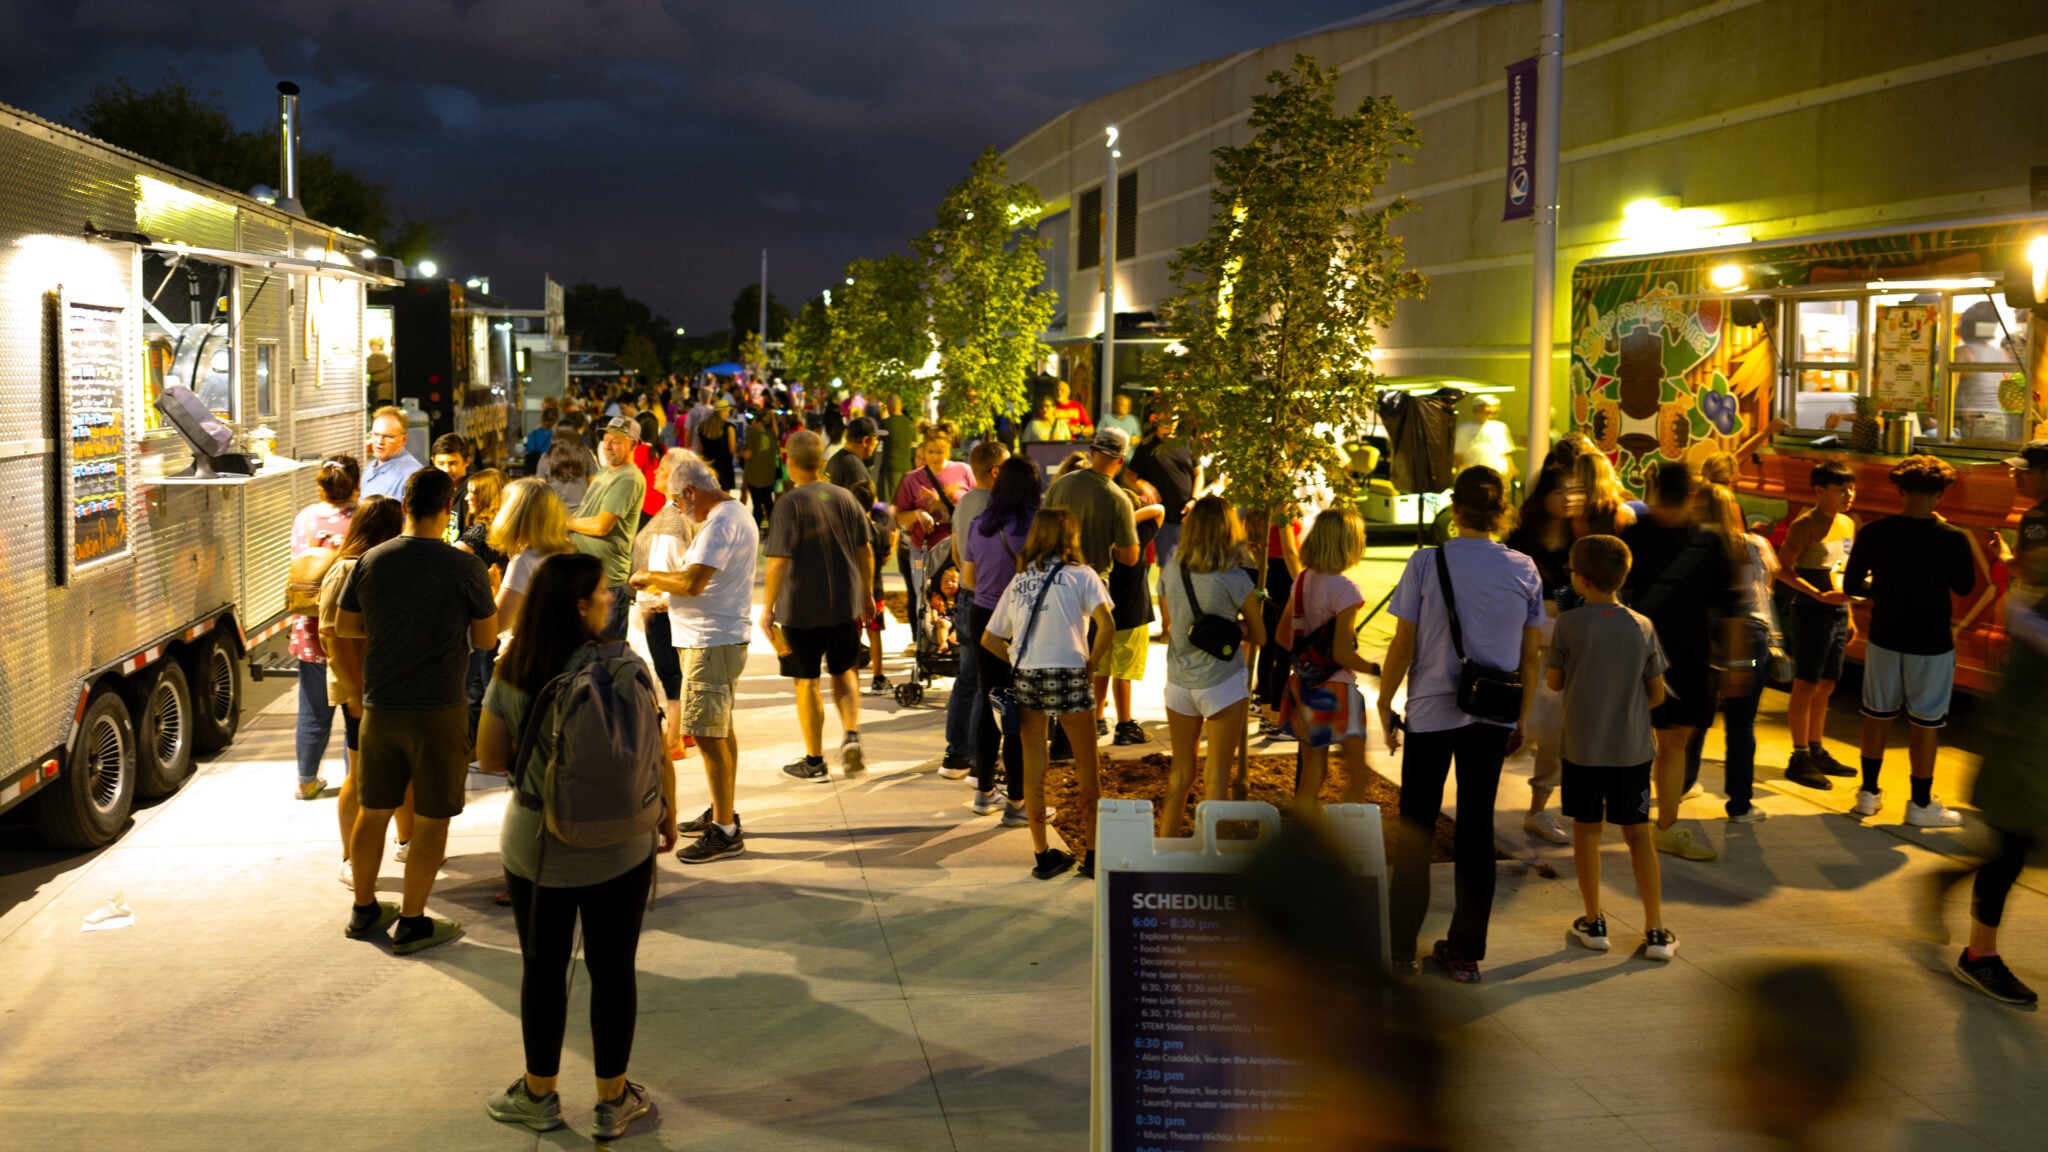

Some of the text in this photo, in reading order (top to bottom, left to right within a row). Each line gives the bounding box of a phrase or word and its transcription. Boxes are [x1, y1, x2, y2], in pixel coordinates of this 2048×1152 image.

[1512, 75, 1522, 166] Exploration
[1519, 121, 1528, 165] Place
[1132, 893, 1236, 911] SCHEDULE
[1132, 917, 1158, 928] 6:00
[1169, 918, 1196, 929] 8:30
[1198, 920, 1219, 931] pm
[1139, 944, 1161, 954] Food
[1134, 1038, 1184, 1051] 6:30 pm
[1135, 1069, 1185, 1082] 7:30 pm
[1135, 1114, 1185, 1128] 8:30 pm
